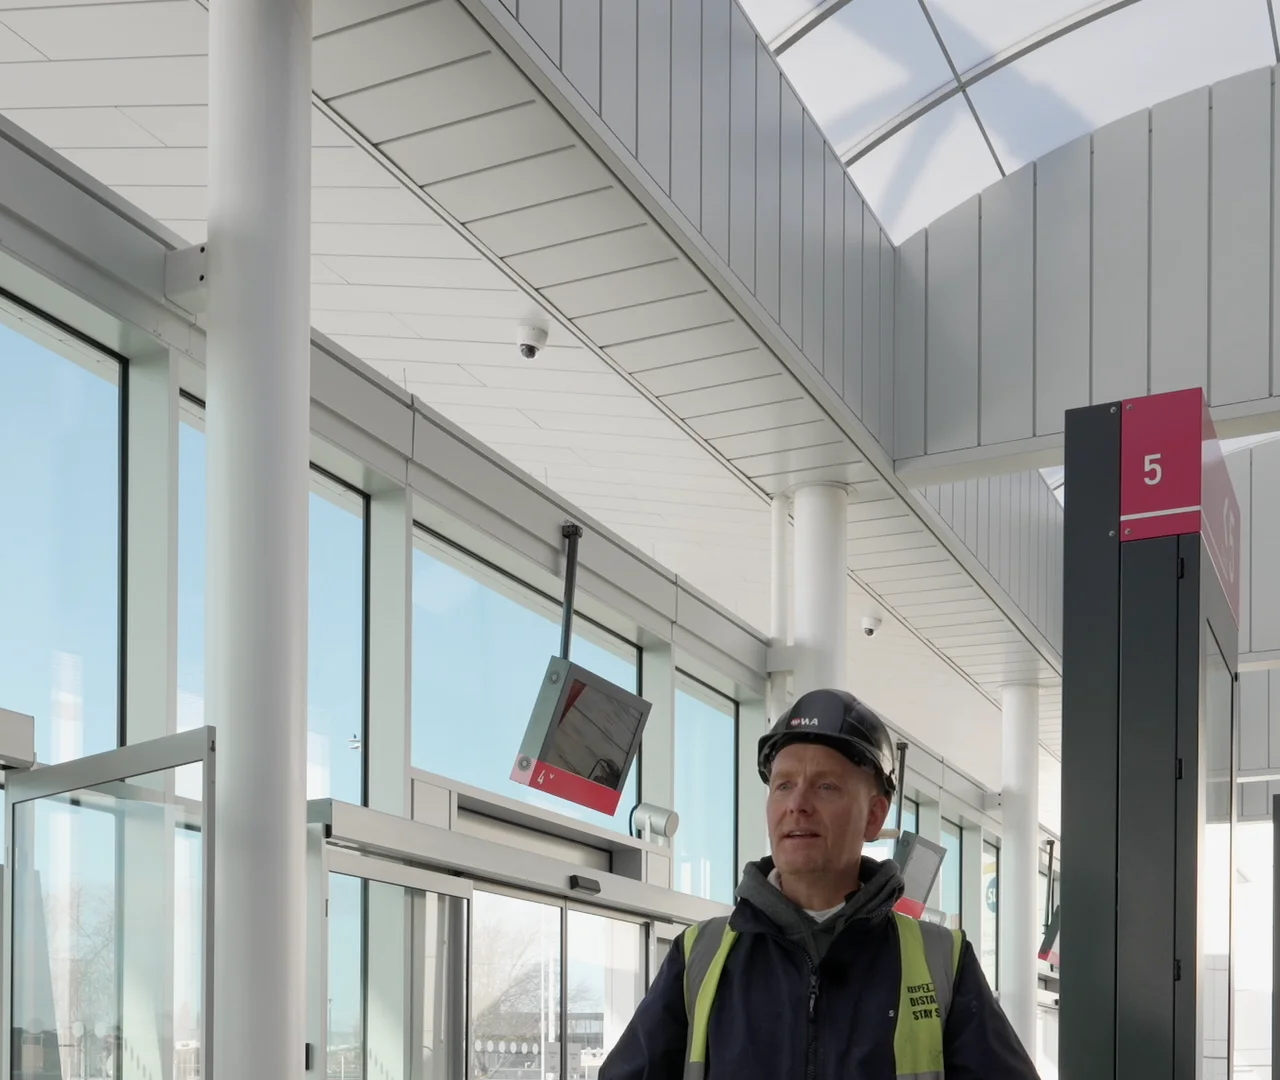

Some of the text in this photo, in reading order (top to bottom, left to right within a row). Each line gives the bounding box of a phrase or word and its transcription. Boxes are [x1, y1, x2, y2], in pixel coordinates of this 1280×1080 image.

[1143, 453, 1162, 485] 5
[537, 769, 546, 785] 4
[909, 995, 937, 1007] DISTA
[912, 1008, 933, 1021] STAY
